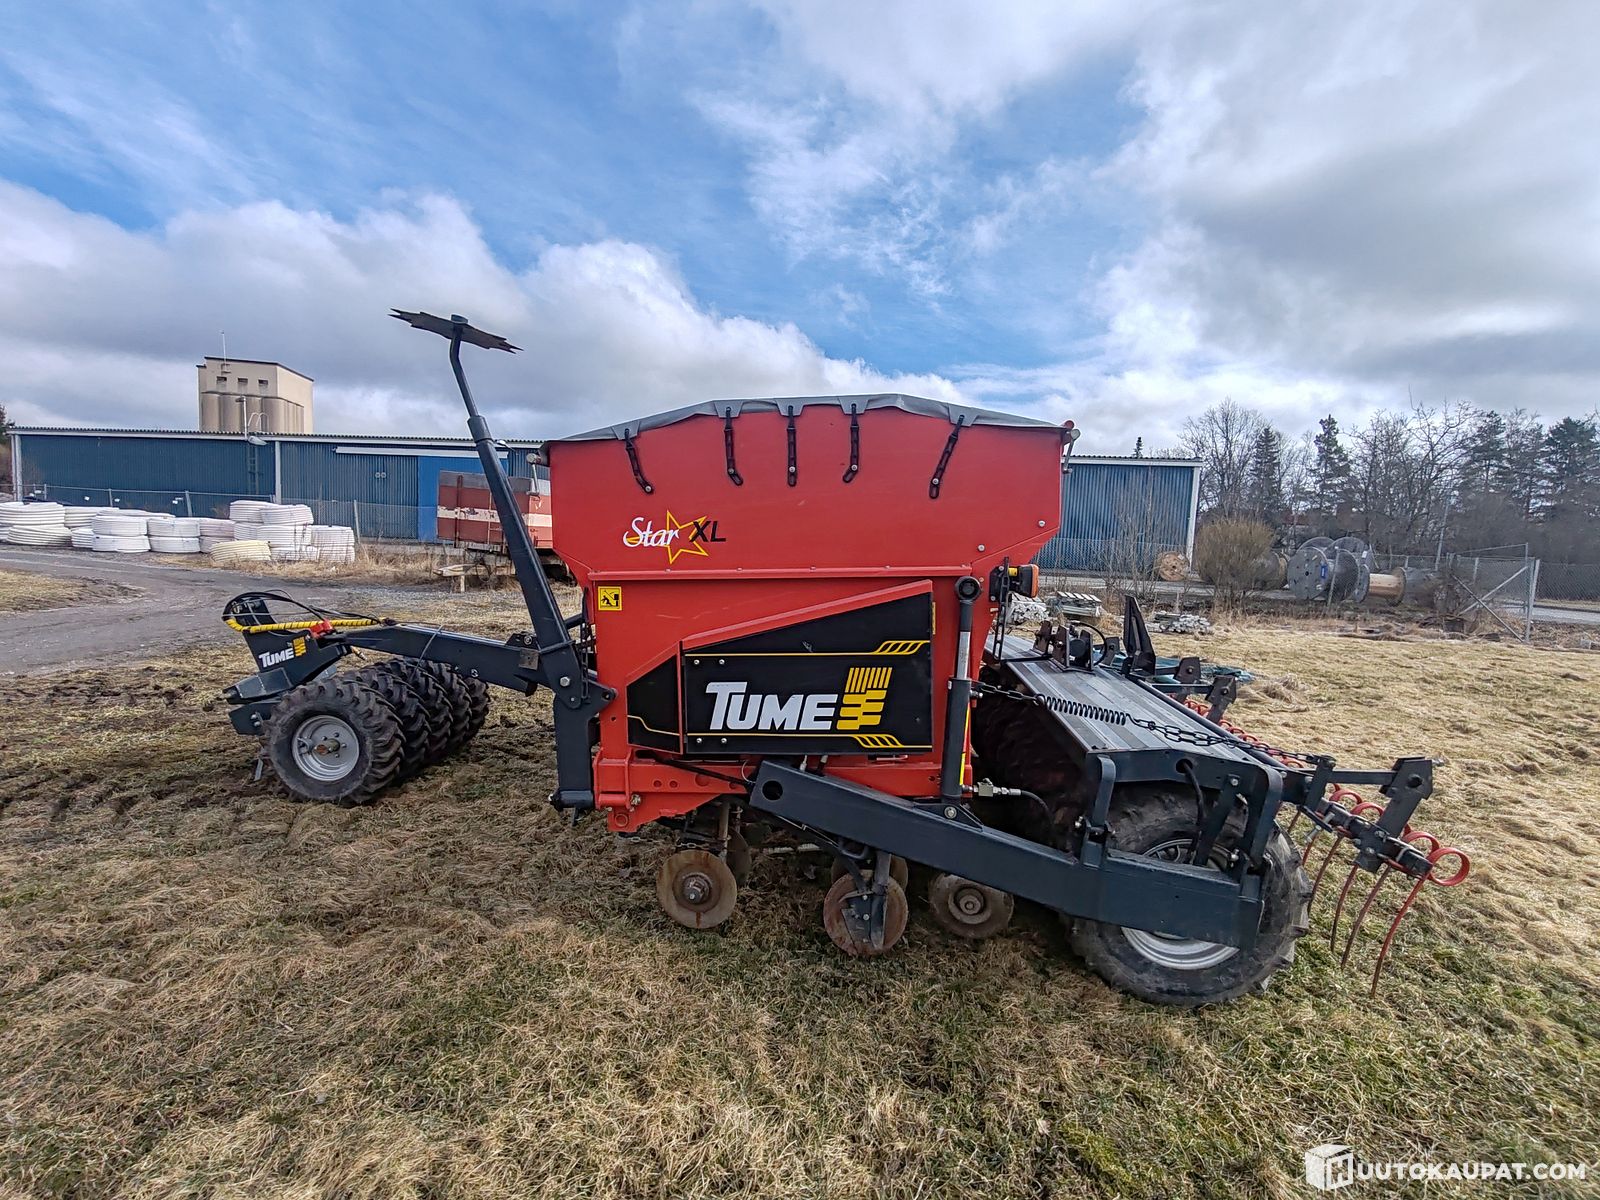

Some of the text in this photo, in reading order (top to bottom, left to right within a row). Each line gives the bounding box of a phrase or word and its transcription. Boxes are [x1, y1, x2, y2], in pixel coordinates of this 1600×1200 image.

[622, 516, 727, 548] Star XL
[258, 647, 295, 668] TUME
[705, 681, 839, 731] TUME
